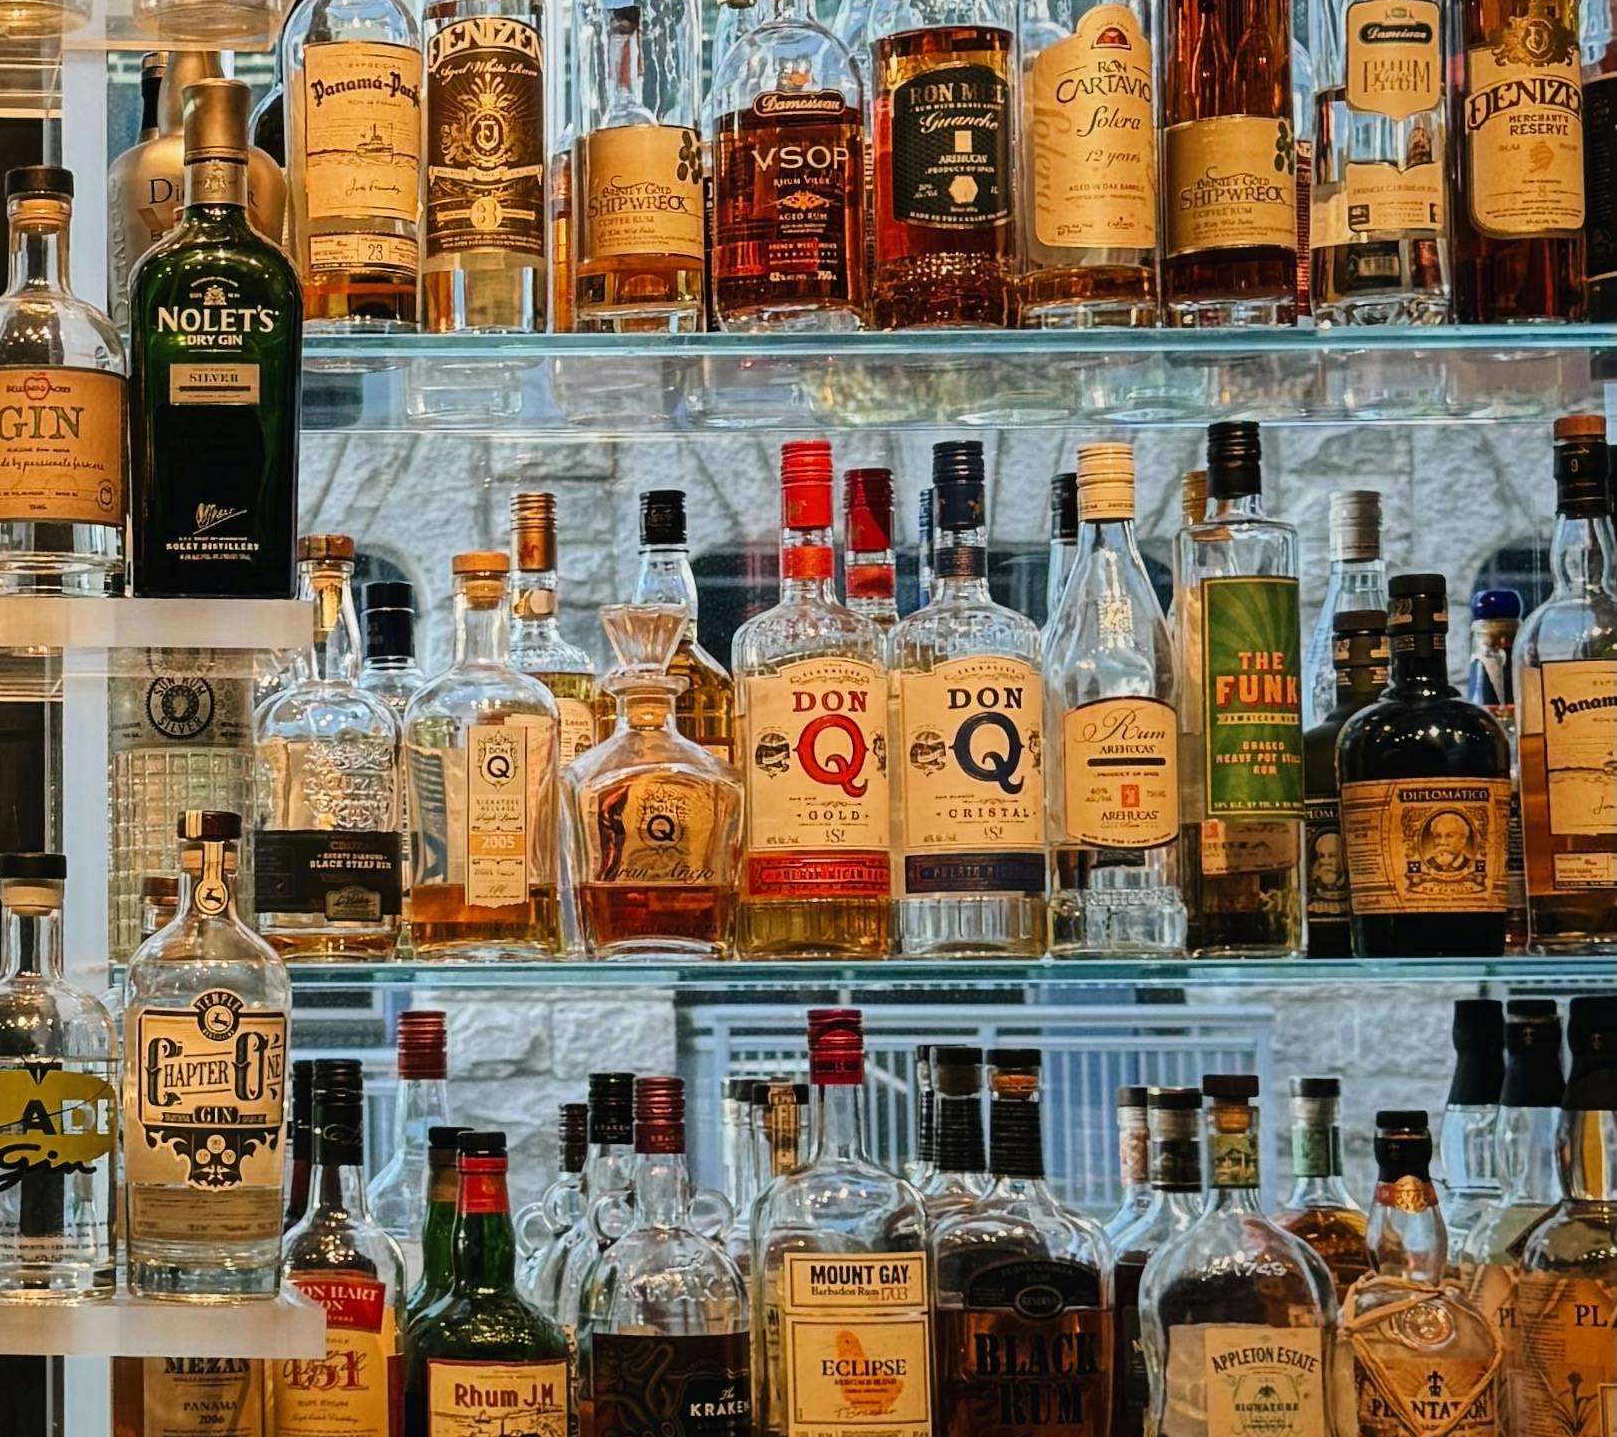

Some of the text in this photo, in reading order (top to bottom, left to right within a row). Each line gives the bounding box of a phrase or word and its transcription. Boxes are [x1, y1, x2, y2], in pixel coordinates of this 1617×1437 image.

[1098, 61, 1127, 74] RON
[1056, 75, 1150, 103] CARTAVIO
[1077, 106, 1141, 137] Solera
[1509, 114, 1569, 124] MERCHANT'S
[1509, 124, 1569, 136] RESERVE
[751, 145, 849, 171] VSOP
[779, 212, 828, 221] AGED RUM
[1192, 207, 1252, 220] COFFEE RUM
[367, 245, 383, 261] 23
[157, 303, 275, 331] NOLET'S
[187, 334, 242, 346] DRY GIN
[188, 372, 239, 384] SILVER
[1238, 651, 1284, 669] THE
[948, 687, 1024, 710] DON
[1215, 675, 1299, 708] FUNK
[792, 690, 867, 713] DON
[1083, 707, 1166, 741] Rum
[489, 745, 508, 754] DON
[796, 714, 869, 798] Q
[951, 712, 1024, 795] Q
[486, 756, 510, 779] Q
[1253, 766, 1276, 776] RUM
[808, 810, 860, 821] GOLD
[948, 808, 1029, 818] CRISTAL
[1101, 810, 1159, 821] AREHUCAS
[646, 814, 675, 843] Q
[482, 835, 515, 850] 2005
[200, 1108, 234, 1123] GIN
[810, 1265, 909, 1287] MOUNT GAY
[811, 1286, 879, 1297] Barbados Rum
[974, 1331, 1099, 1377] BLACK
[1212, 1346, 1319, 1373] APPLETON ESTATE
[821, 1359, 907, 1377] ECLIPSE
[182, 1401, 239, 1412] PANAMA
[999, 1384, 1082, 1426] RUM
